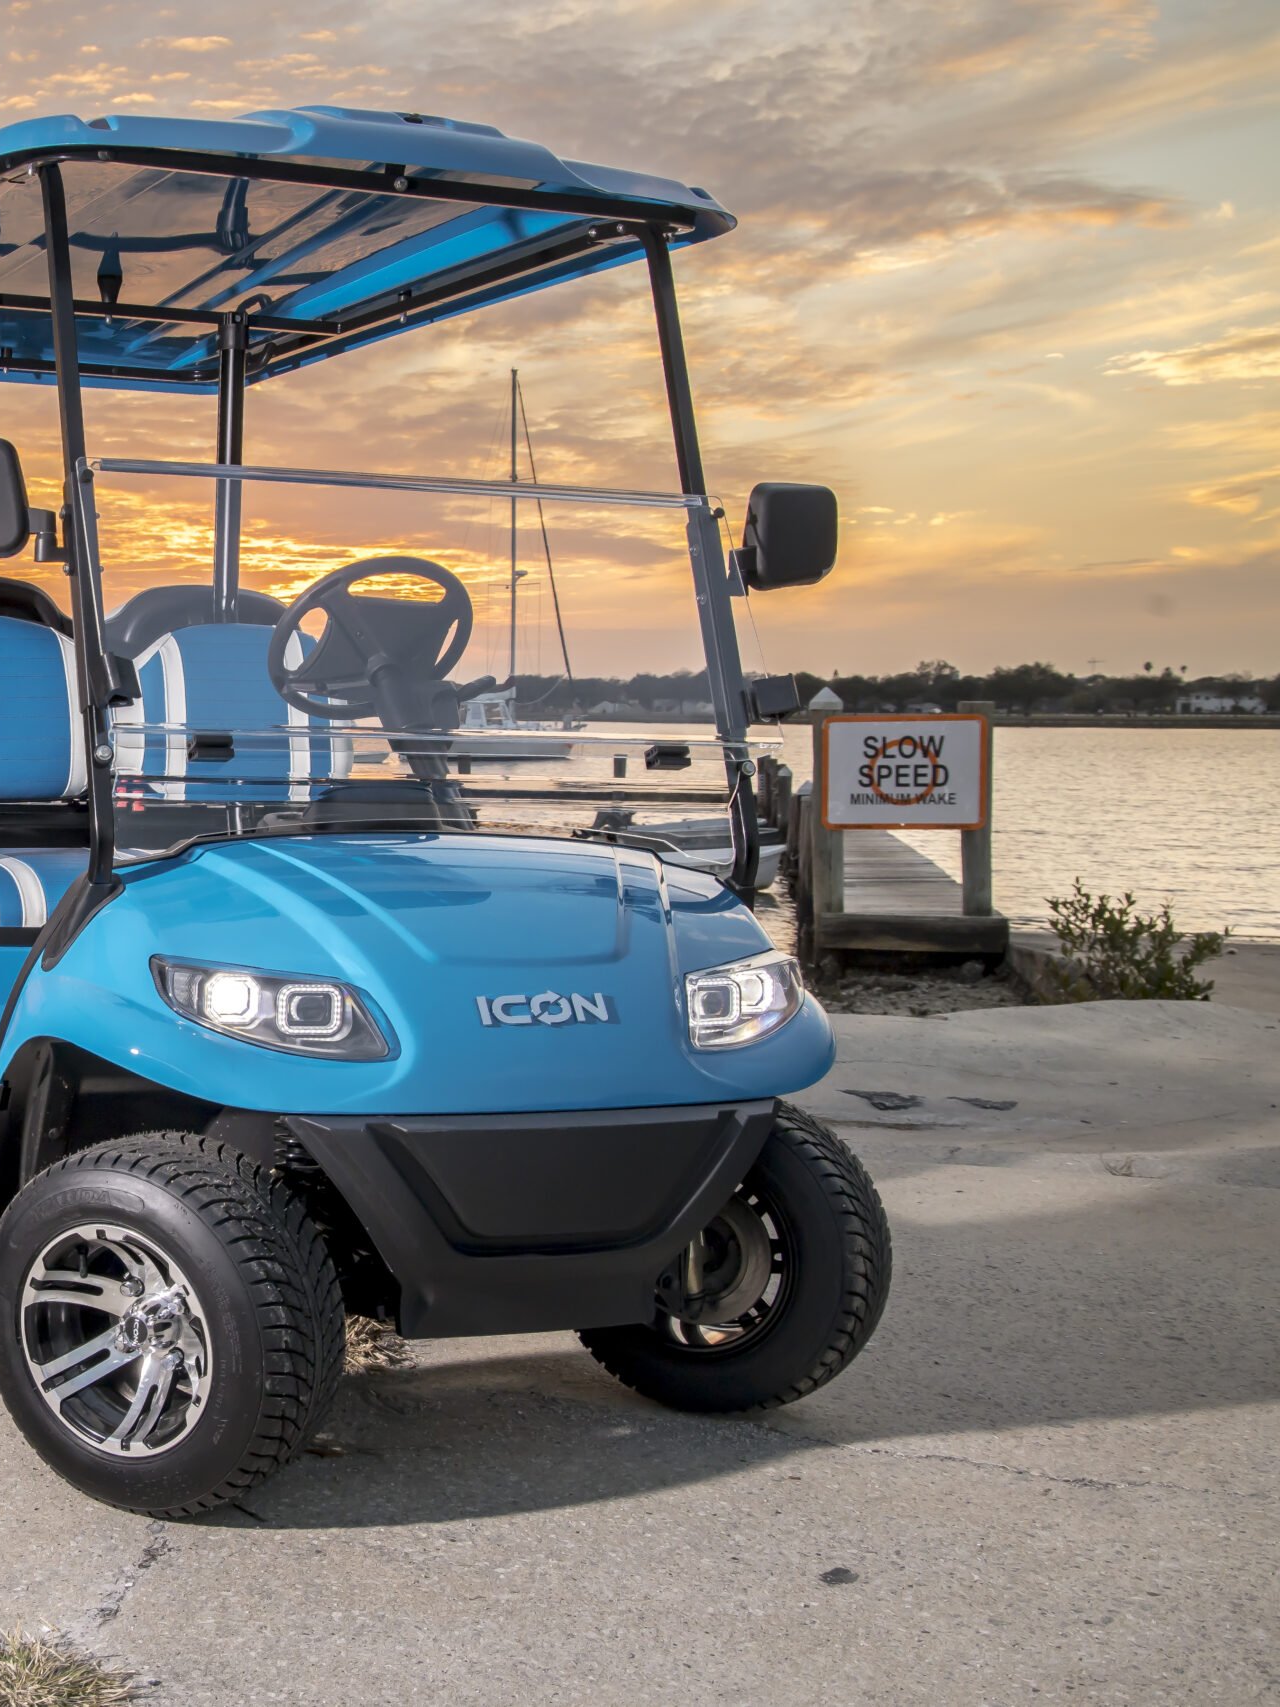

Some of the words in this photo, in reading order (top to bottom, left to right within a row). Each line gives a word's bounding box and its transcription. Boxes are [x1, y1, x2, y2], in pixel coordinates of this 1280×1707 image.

[863, 735, 945, 759] SLOW
[858, 764, 949, 788] SPEED
[850, 793, 912, 805] MINIMUM
[915, 793, 957, 805] WAKE
[476, 990, 609, 1026] ICON
